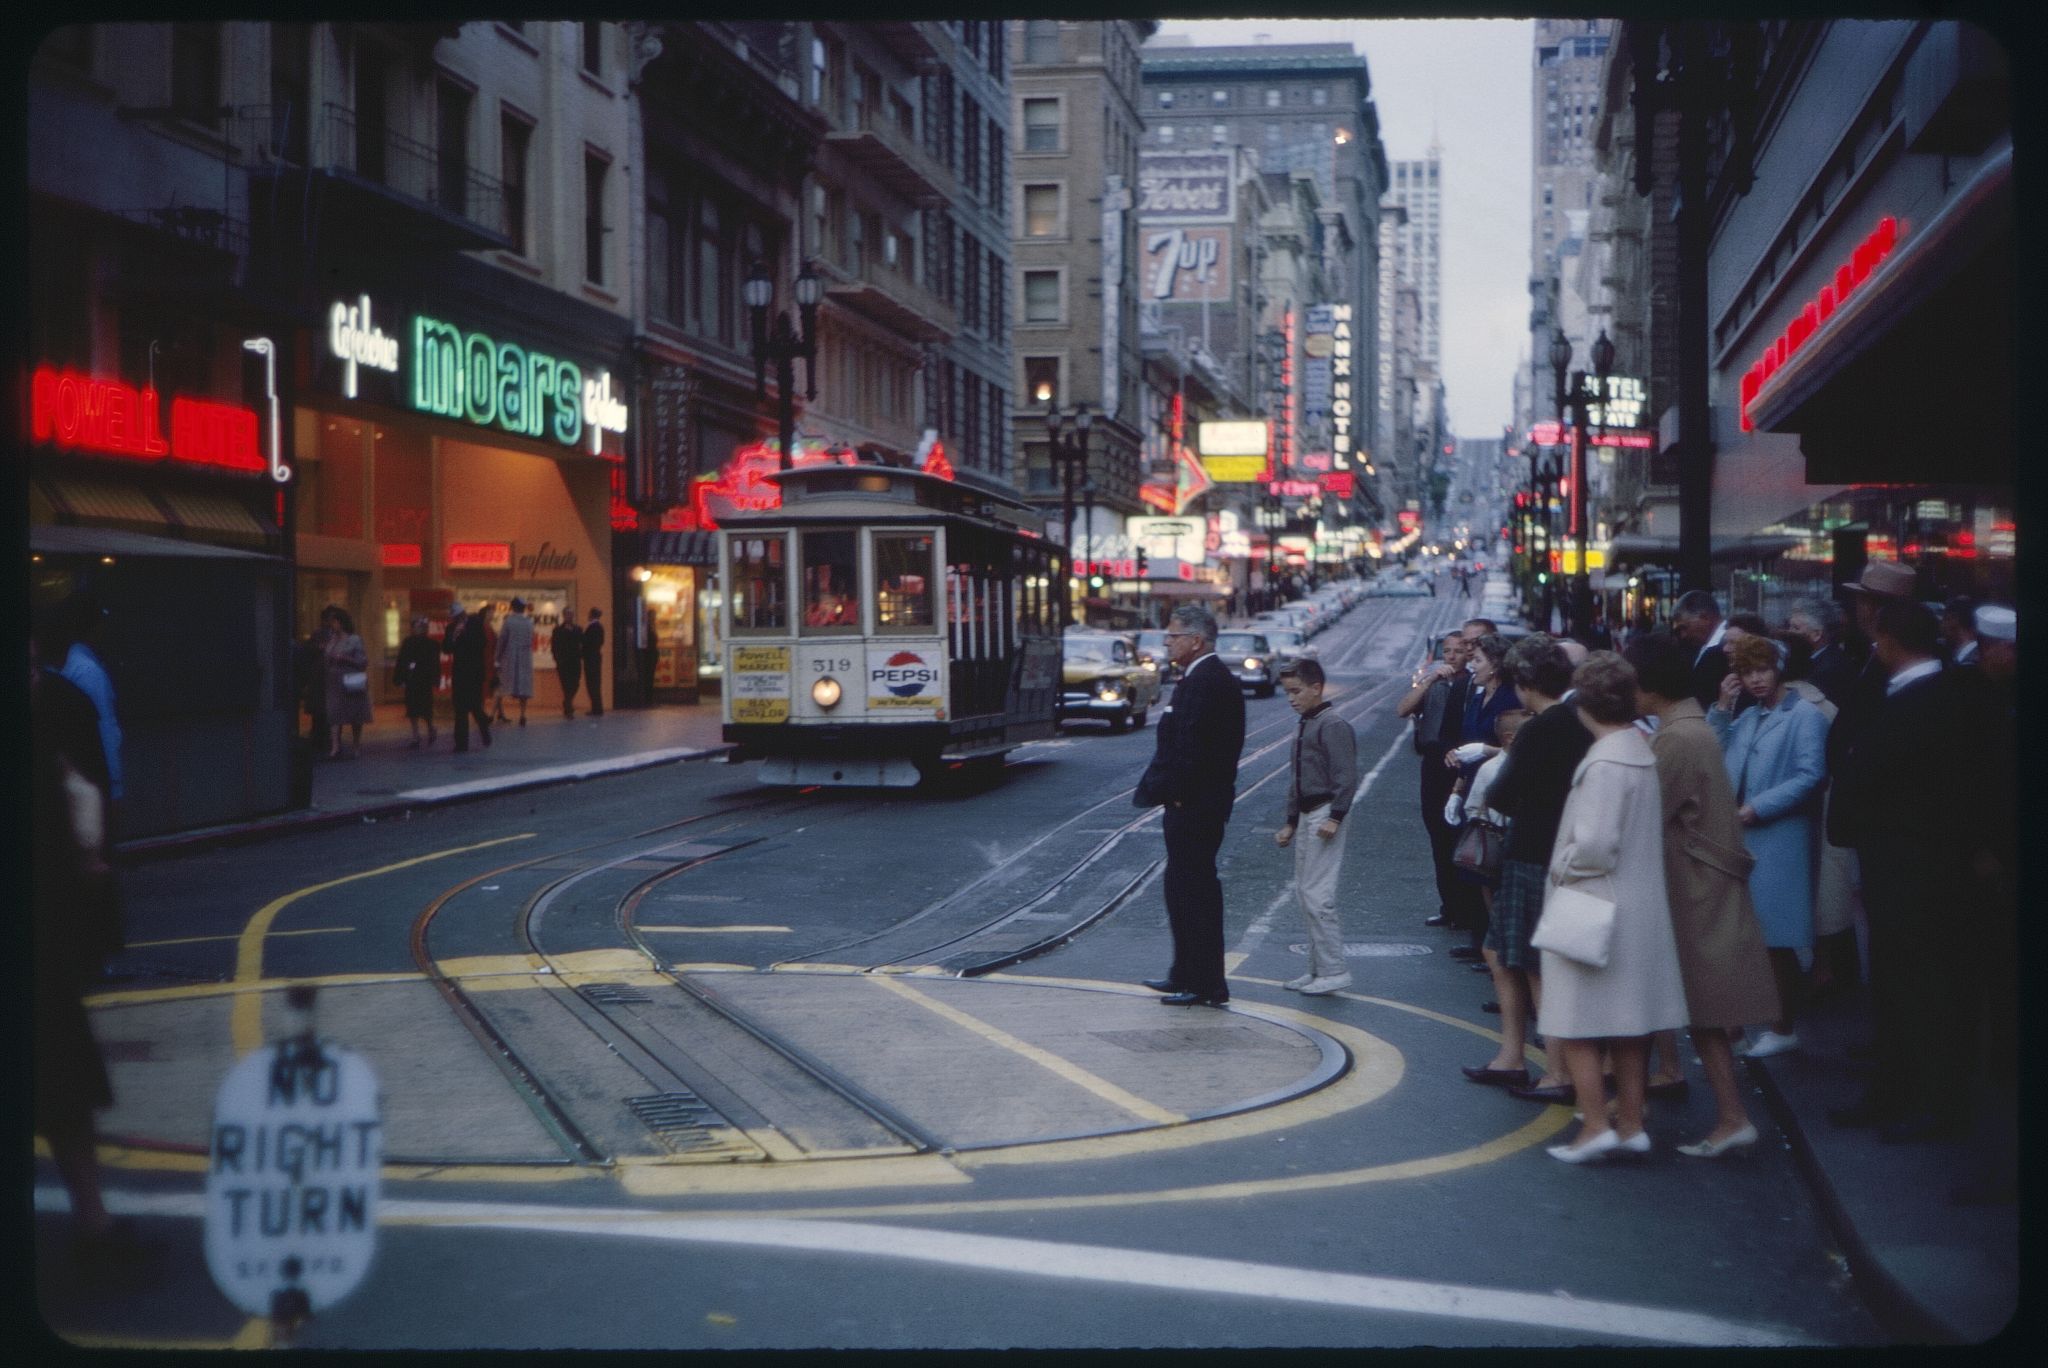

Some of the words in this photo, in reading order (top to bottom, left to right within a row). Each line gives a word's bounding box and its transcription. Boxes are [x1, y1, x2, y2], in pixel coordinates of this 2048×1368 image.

[1333, 304, 1352, 376] MANX
[34, 367, 168, 458] POWELL
[172, 397, 268, 471] HOTEL
[1333, 382, 1352, 470] HOTEL
[738, 662, 785, 671] MARKET
[739, 650, 784, 660] POWELL
[872, 669, 938, 682] PEPSI
[738, 708, 785, 719] TAYLOR
[268, 1055, 338, 1107] NO
[214, 1121, 380, 1174] RIGHT
[224, 1186, 367, 1239] TURN
